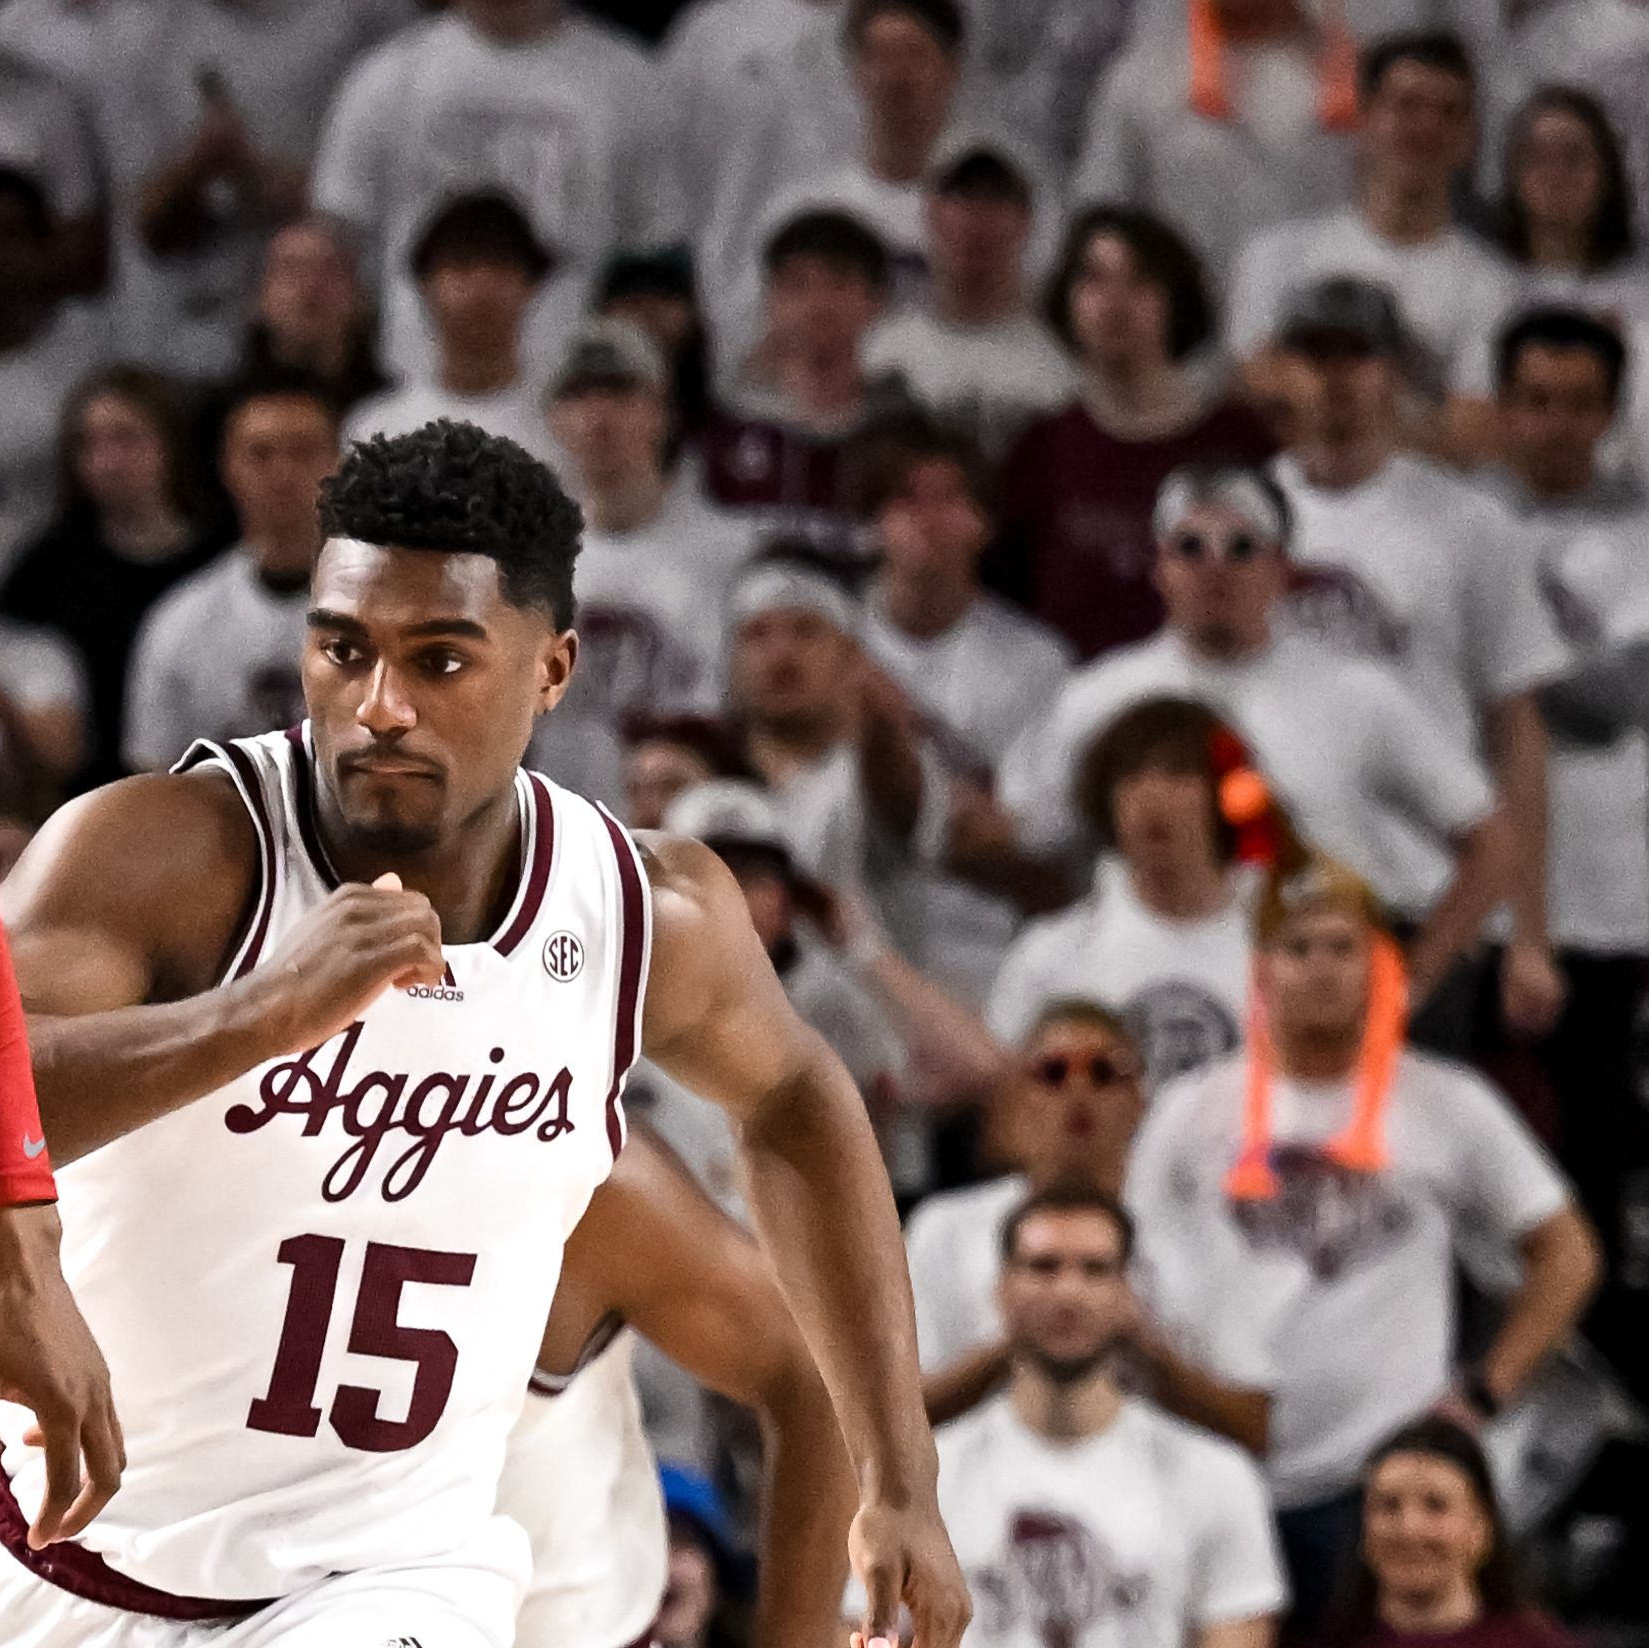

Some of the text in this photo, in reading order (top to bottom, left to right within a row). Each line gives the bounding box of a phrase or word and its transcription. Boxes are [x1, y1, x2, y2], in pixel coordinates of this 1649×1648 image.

[407, 985, 464, 1002] adidas
[547, 934, 580, 977] SEC
[224, 1021, 576, 1203] Aggies
[245, 1232, 478, 1453] 15
